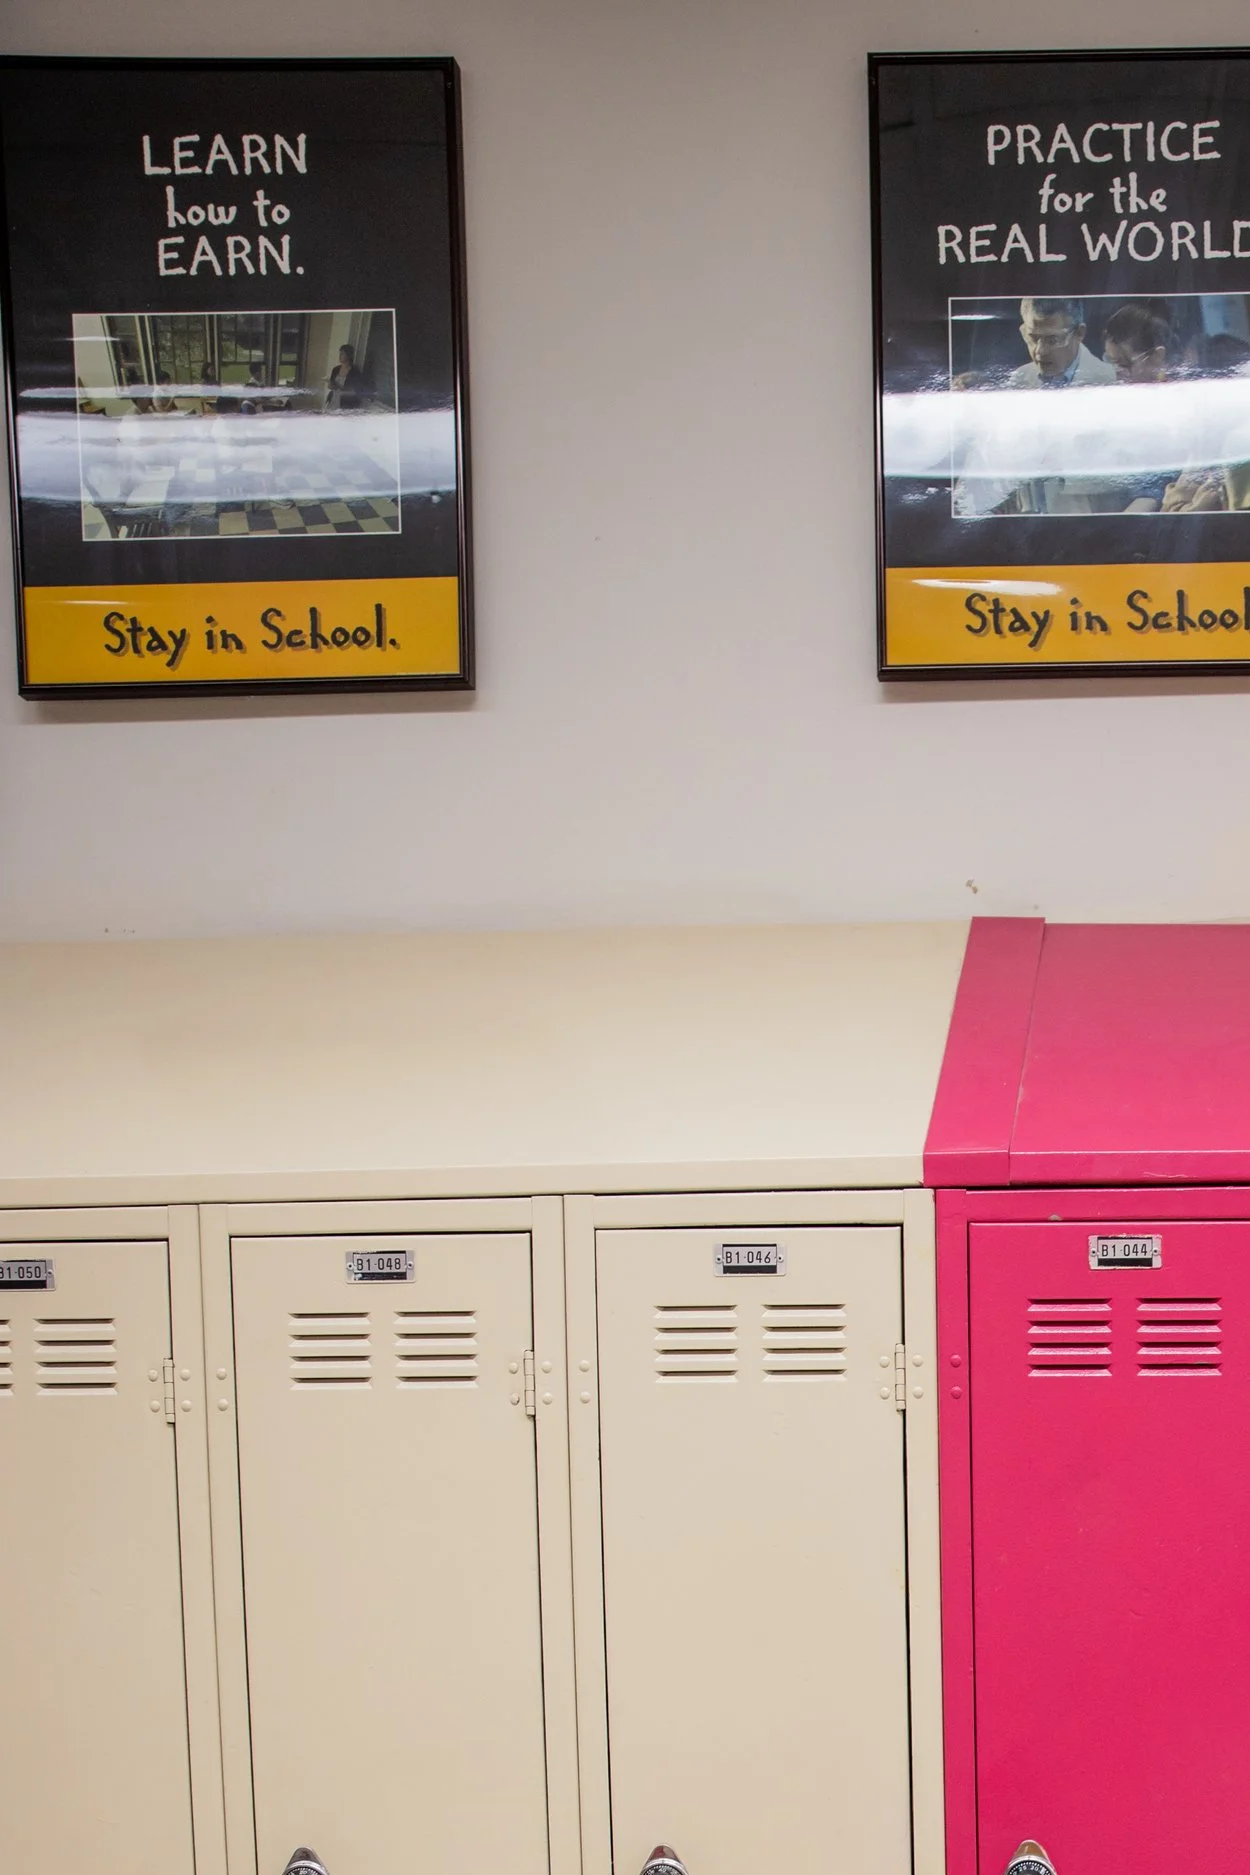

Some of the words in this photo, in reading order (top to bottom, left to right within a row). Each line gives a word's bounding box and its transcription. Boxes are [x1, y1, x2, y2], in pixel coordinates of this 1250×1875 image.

[142, 133, 308, 176] LEARN
[986, 120, 1222, 166] PRACTICE
[165, 185, 237, 228] how
[252, 189, 291, 227] to
[1038, 173, 1094, 215] for
[1108, 171, 1168, 215] the
[158, 234, 305, 276] EARN.
[937, 223, 1067, 265] REAL
[103, 610, 190, 670] Stay
[205, 614, 244, 652] in
[260, 602, 400, 651] School.
[965, 592, 1052, 649] Stay
[1070, 597, 1109, 634] in
[356, 1257, 402, 1271] B1-048
